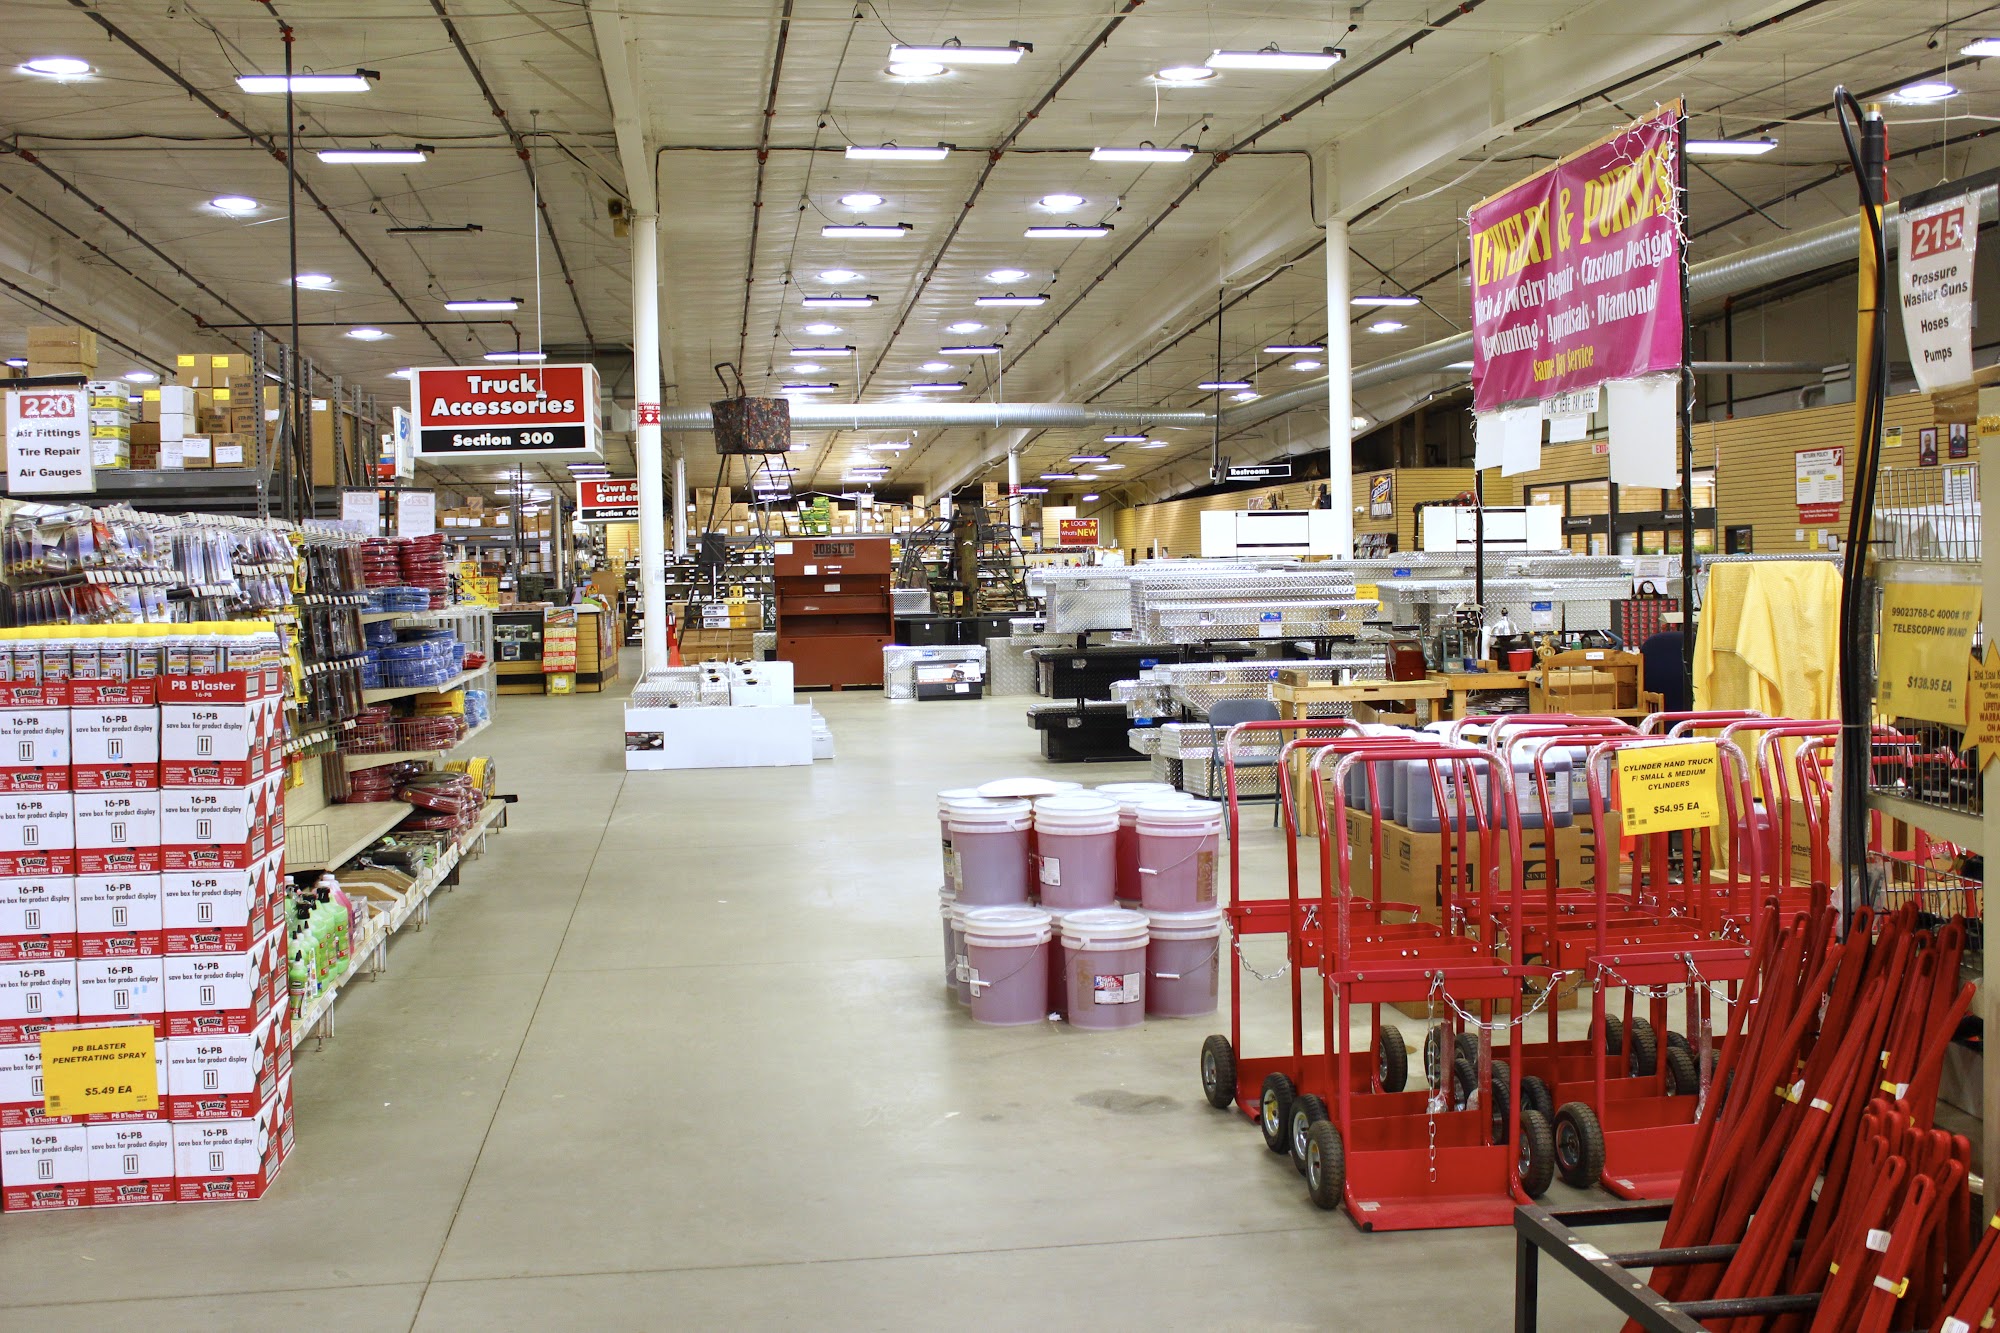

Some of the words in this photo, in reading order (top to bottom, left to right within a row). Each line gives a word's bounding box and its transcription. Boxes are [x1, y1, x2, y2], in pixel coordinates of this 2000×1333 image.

[1473, 197, 1552, 290] JEWELRY
[1560, 187, 1574, 250] &
[1580, 140, 1672, 244] PURSES
[1914, 213, 1960, 256] 215
[1494, 290, 1502, 318] &
[1547, 262, 1574, 301] Repair
[1581, 247, 1624, 286] Custom
[1624, 229, 1673, 272] Designs
[1912, 264, 1957, 287] Pressure
[1903, 286, 1937, 308] Washer
[1940, 280, 1968, 297] Guns
[1546, 301, 1590, 345] Appraisals
[1598, 279, 1657, 326] Diamond
[1921, 316, 1948, 334] Hoses
[1924, 346, 1952, 362] Pumps
[1533, 358, 1555, 382] Same
[1555, 353, 1566, 377] Day
[1567, 344, 1594, 372] Service
[467, 373, 536, 394] Truck
[25, 397, 71, 416] 220
[431, 398, 575, 416] Accessories
[16, 430, 32, 438] Air
[37, 429, 80, 438] Fittings
[452, 432, 511, 447] Section
[520, 432, 554, 445] 300
[18, 448, 40, 456] Tire
[44, 448, 80, 457] Repair
[20, 468, 36, 477] Air
[40, 468, 82, 478] Gauges
[596, 484, 626, 492] Lawn
[1077, 528, 1097, 536] NEW
[814, 543, 854, 554] JOBSITE
[1892, 608, 1935, 618] 99023768-C
[1937, 610, 1959, 619] 4000#
[1893, 624, 1945, 636] TELESCOPING
[1947, 627, 1967, 637] WAND
[171, 681, 187, 690] PB
[191, 680, 236, 690] B'laster
[1907, 676, 1939, 692] $138.95
[1941, 679, 1952, 692] EA
[202, 722, 222, 730] product
[224, 722, 242, 730] display
[1987, 724, 1995, 732] ON
[1624, 763, 1661, 772] CYLINDER
[1664, 760, 1685, 768] HAND
[1688, 758, 1713, 766] TRUCK
[1640, 772, 1664, 781] SMALL
[1675, 769, 1706, 777] MEDIUM
[1648, 781, 1690, 790] CYLINDERS
[191, 796, 216, 804] 16-PB
[201, 806, 221, 814] product
[222, 806, 242, 814] display
[1653, 803, 1684, 814] $54.95
[1687, 802, 1699, 810] EA
[202, 890, 222, 898] product
[223, 889, 242, 897] display
[204, 972, 224, 981] product
[225, 972, 244, 980] display
[86, 1043, 126, 1051] BLASTER
[52, 1054, 115, 1064] PENETRATING
[207, 1056, 227, 1065] product
[228, 1056, 247, 1064] display
[85, 1087, 114, 1096] $5.49
[213, 1138, 233, 1147] product
[234, 1137, 253, 1145] display
